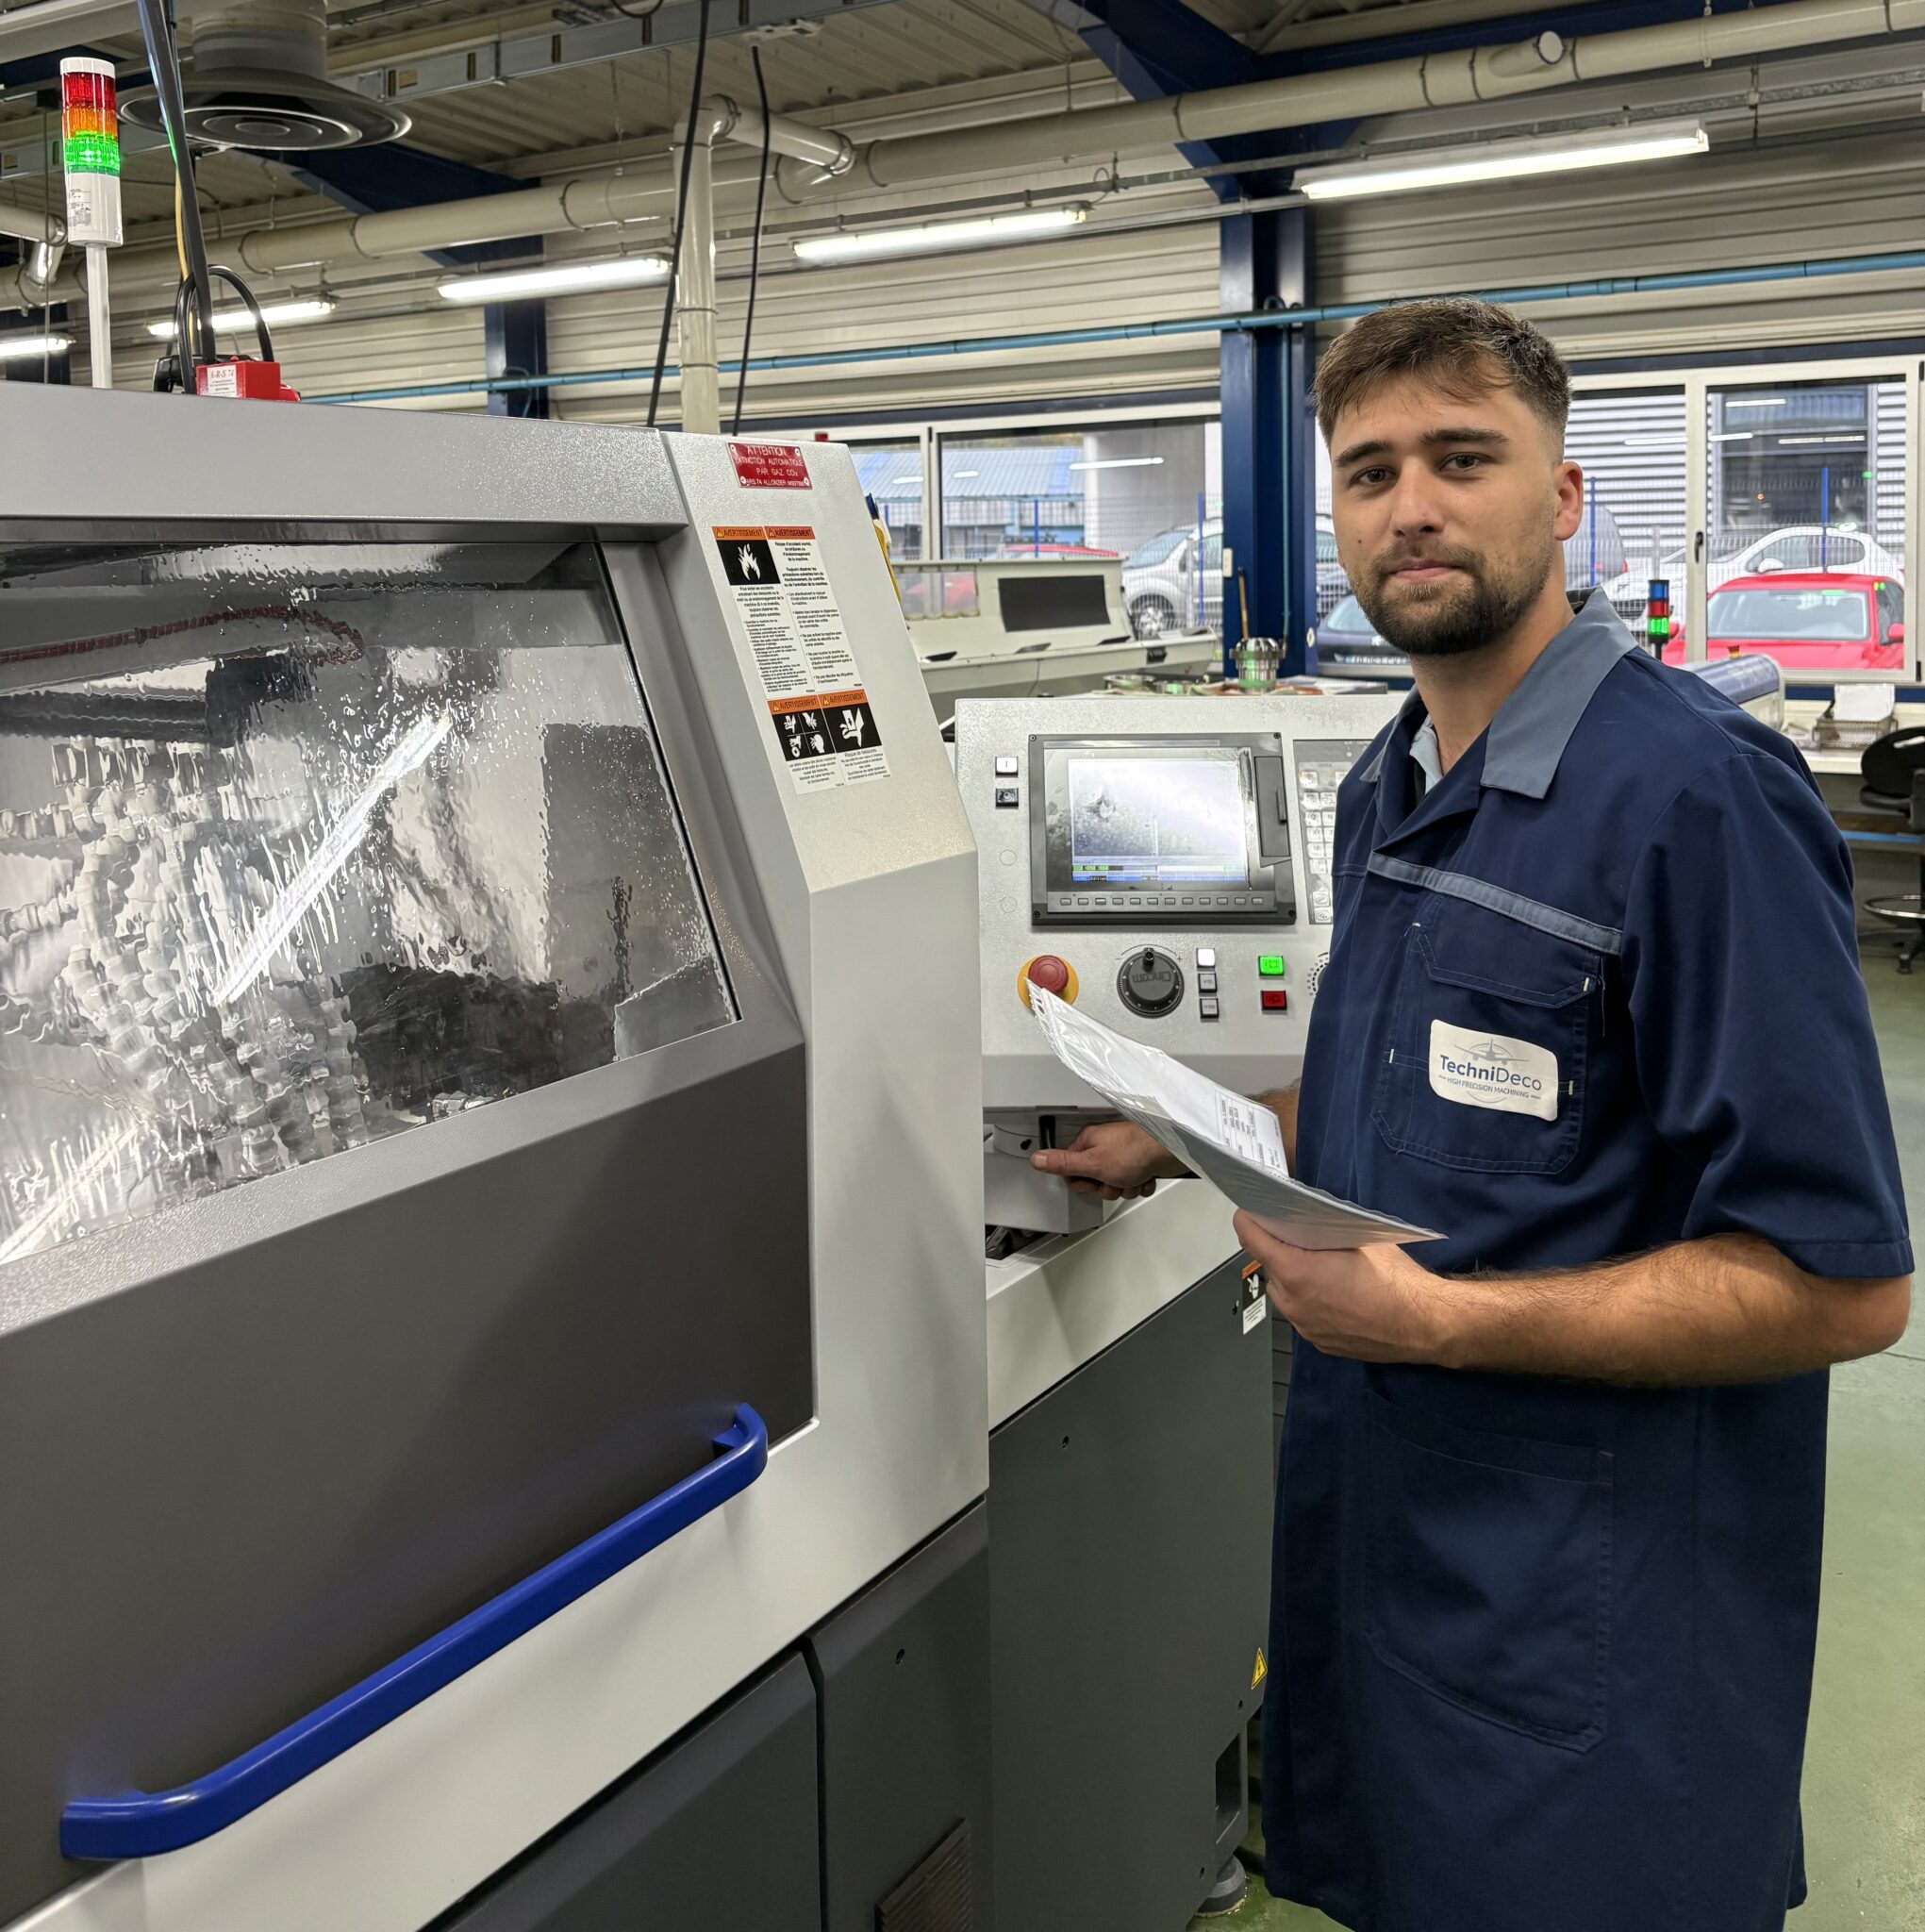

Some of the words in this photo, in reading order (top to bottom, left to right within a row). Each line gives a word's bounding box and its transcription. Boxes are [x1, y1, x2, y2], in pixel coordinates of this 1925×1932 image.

[747, 445, 787, 457] ATTENTION
[768, 458, 805, 467] AUTOMATIQUE
[772, 468, 785, 476] GAZ
[723, 528, 763, 538] AVERTISSEMENT
[774, 528, 811, 538] AVERTISSEMENT
[830, 691, 865, 703] AVERTISSEMENT
[779, 698, 817, 709] AVERTISSEMENT
[1439, 1054, 1542, 1091] TechniDeco
[1447, 1076, 1463, 1087] HIGH
[1462, 1079, 1493, 1092] PRECISION
[1494, 1086, 1529, 1098] MACHINING
